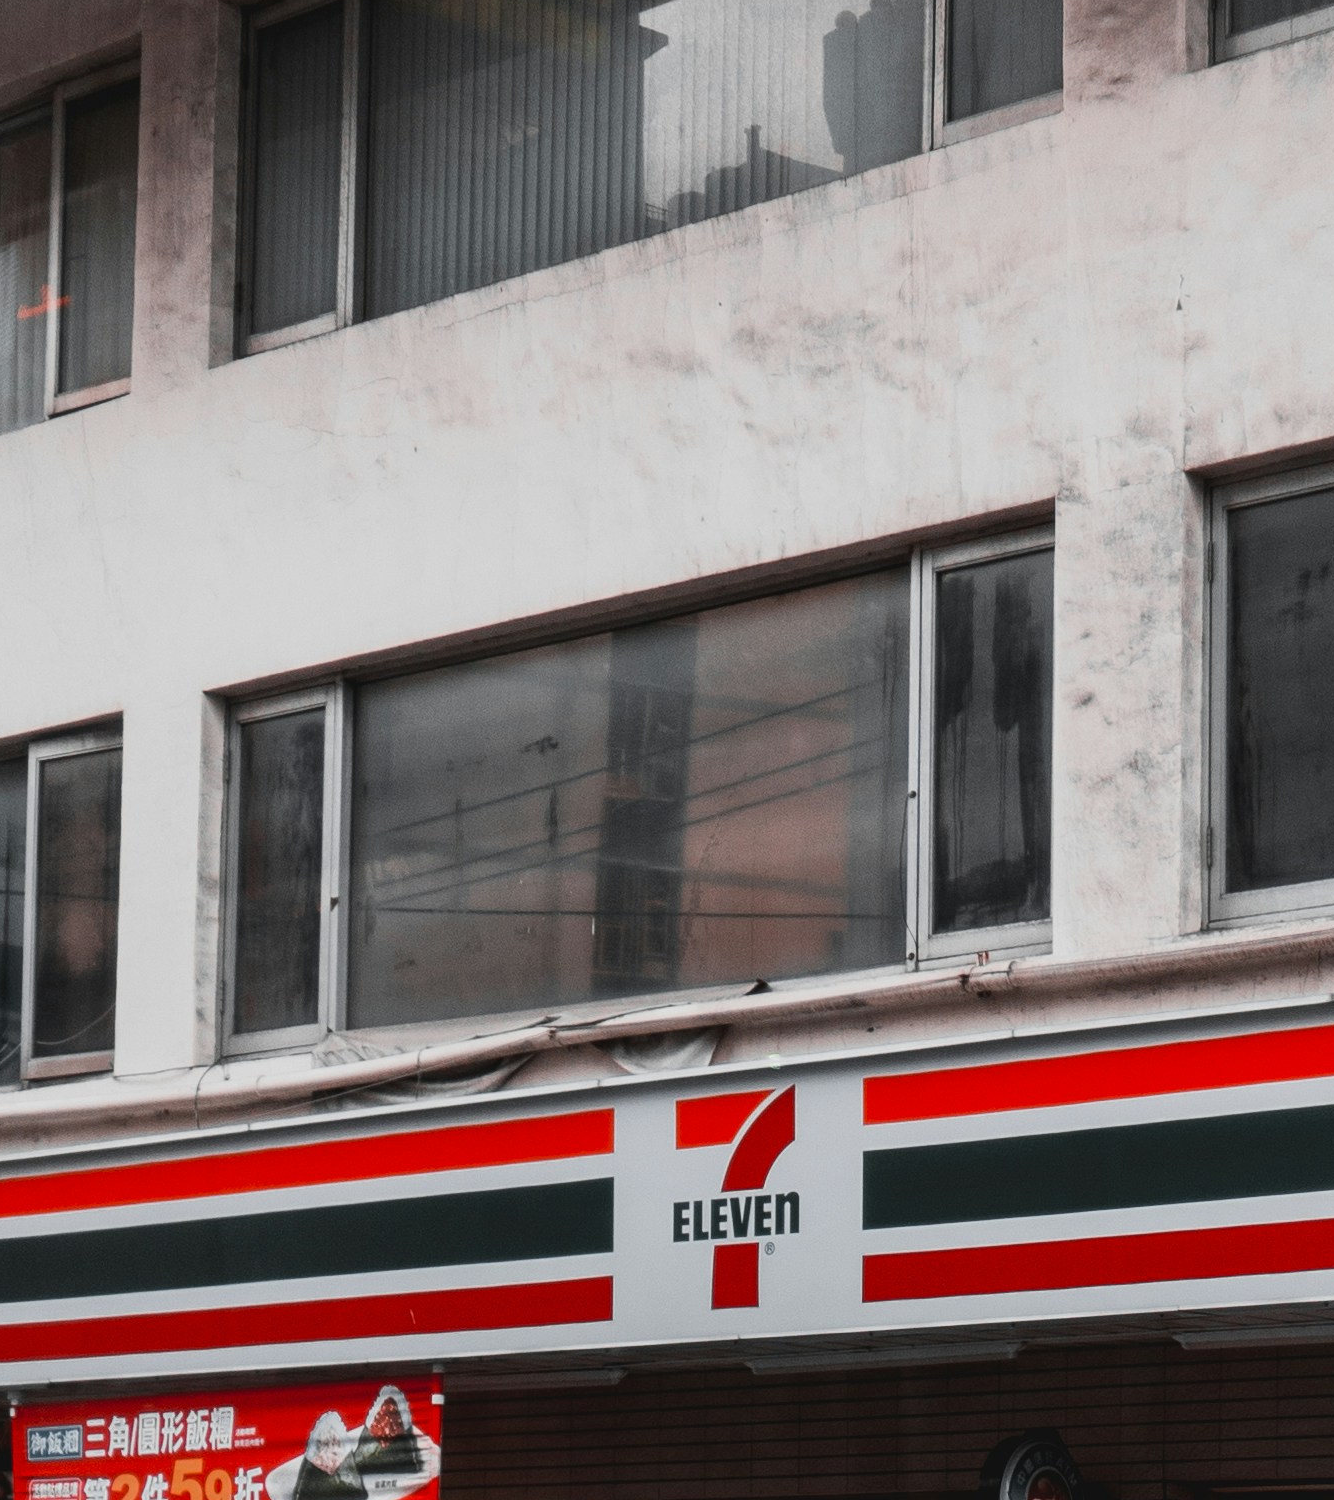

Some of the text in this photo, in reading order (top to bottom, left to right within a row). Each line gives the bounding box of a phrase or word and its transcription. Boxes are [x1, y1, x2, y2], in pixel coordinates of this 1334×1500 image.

[85, 1406, 235, 1458] 三角/圓形飯糰
